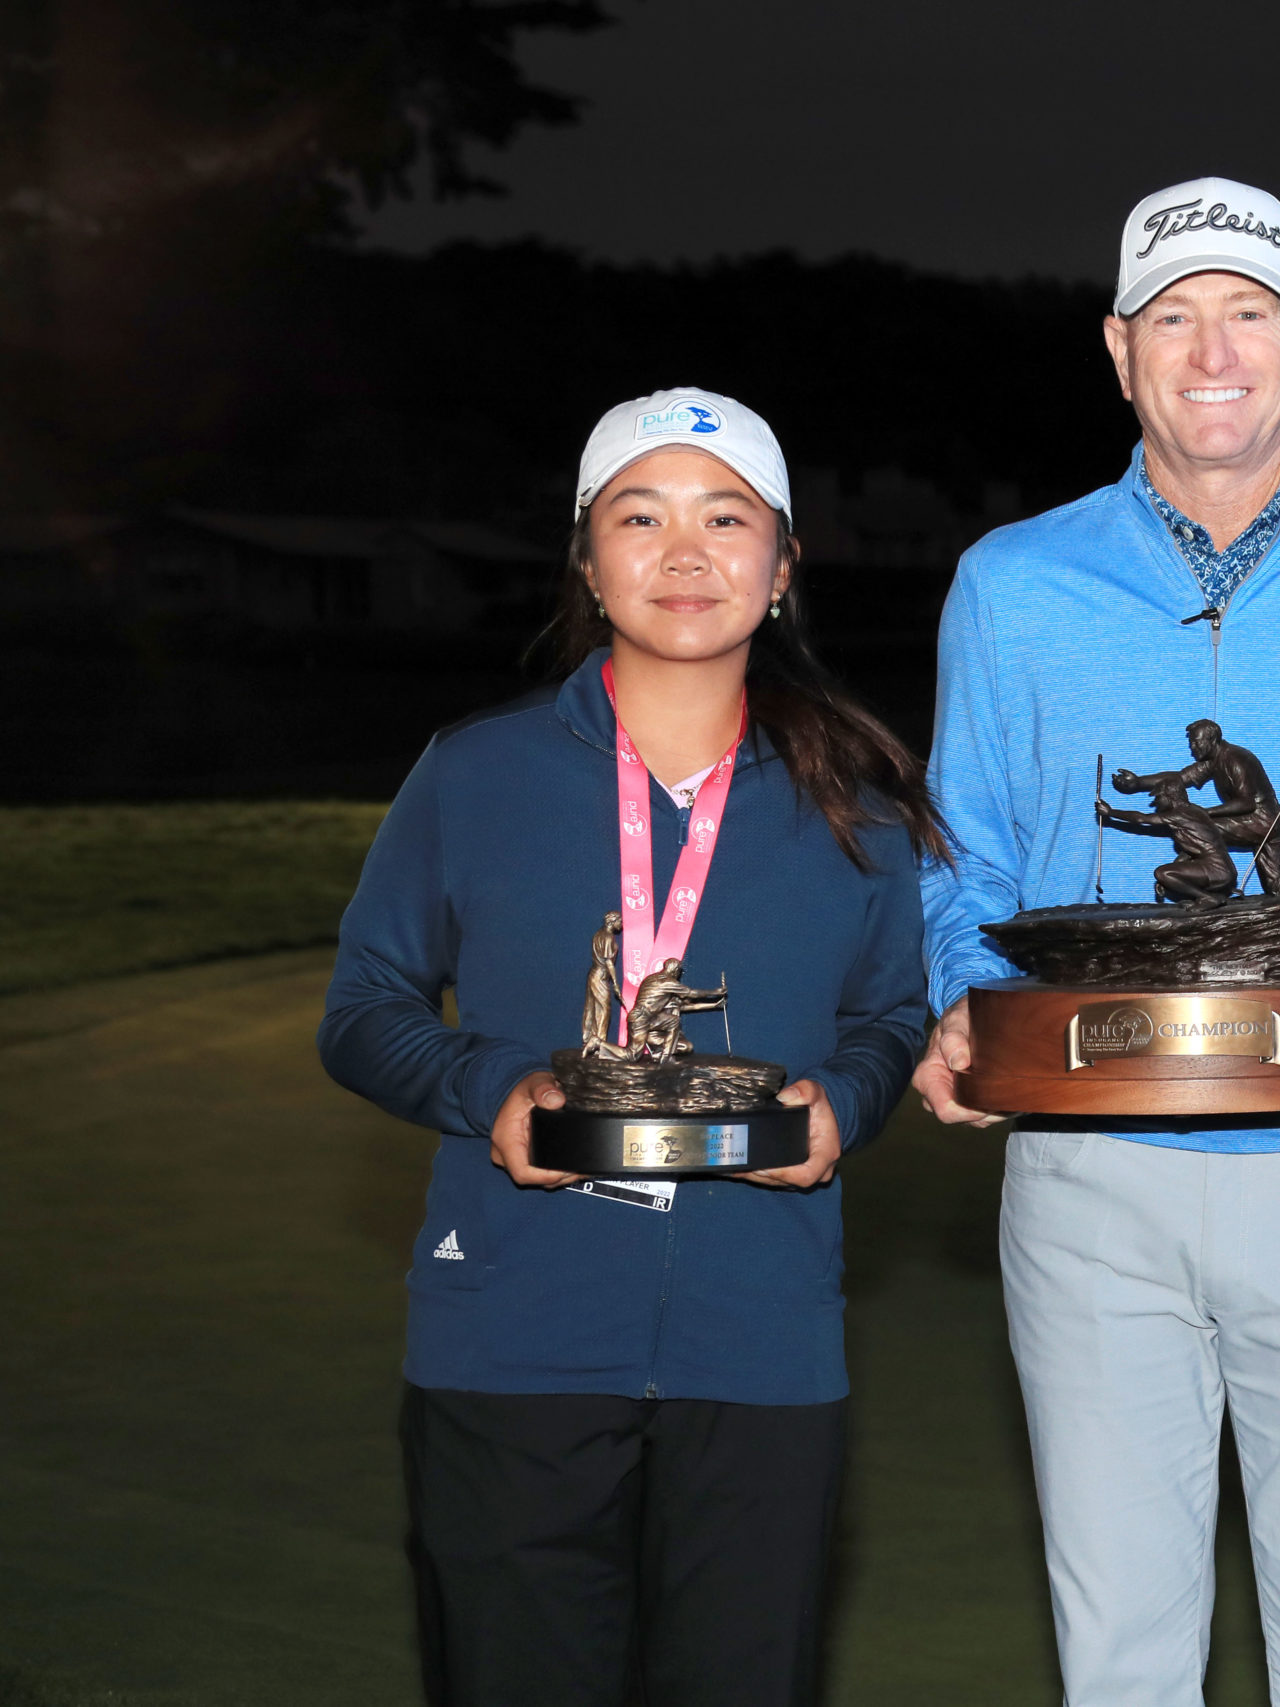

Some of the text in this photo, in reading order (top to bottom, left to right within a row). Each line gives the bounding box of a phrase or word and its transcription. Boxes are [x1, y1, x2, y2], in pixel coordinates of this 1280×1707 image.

[642, 410, 691, 429] pure
[713, 765, 728, 784] pure
[627, 800, 638, 823] pure
[695, 831, 707, 853] pure
[631, 874, 641, 897] pure
[675, 900, 688, 922] pure
[633, 950, 642, 973] pure
[1158, 1020, 1268, 1038] CHAMPION
[656, 1189, 671, 1197] 2022
[433, 1249, 465, 1260] adidas
